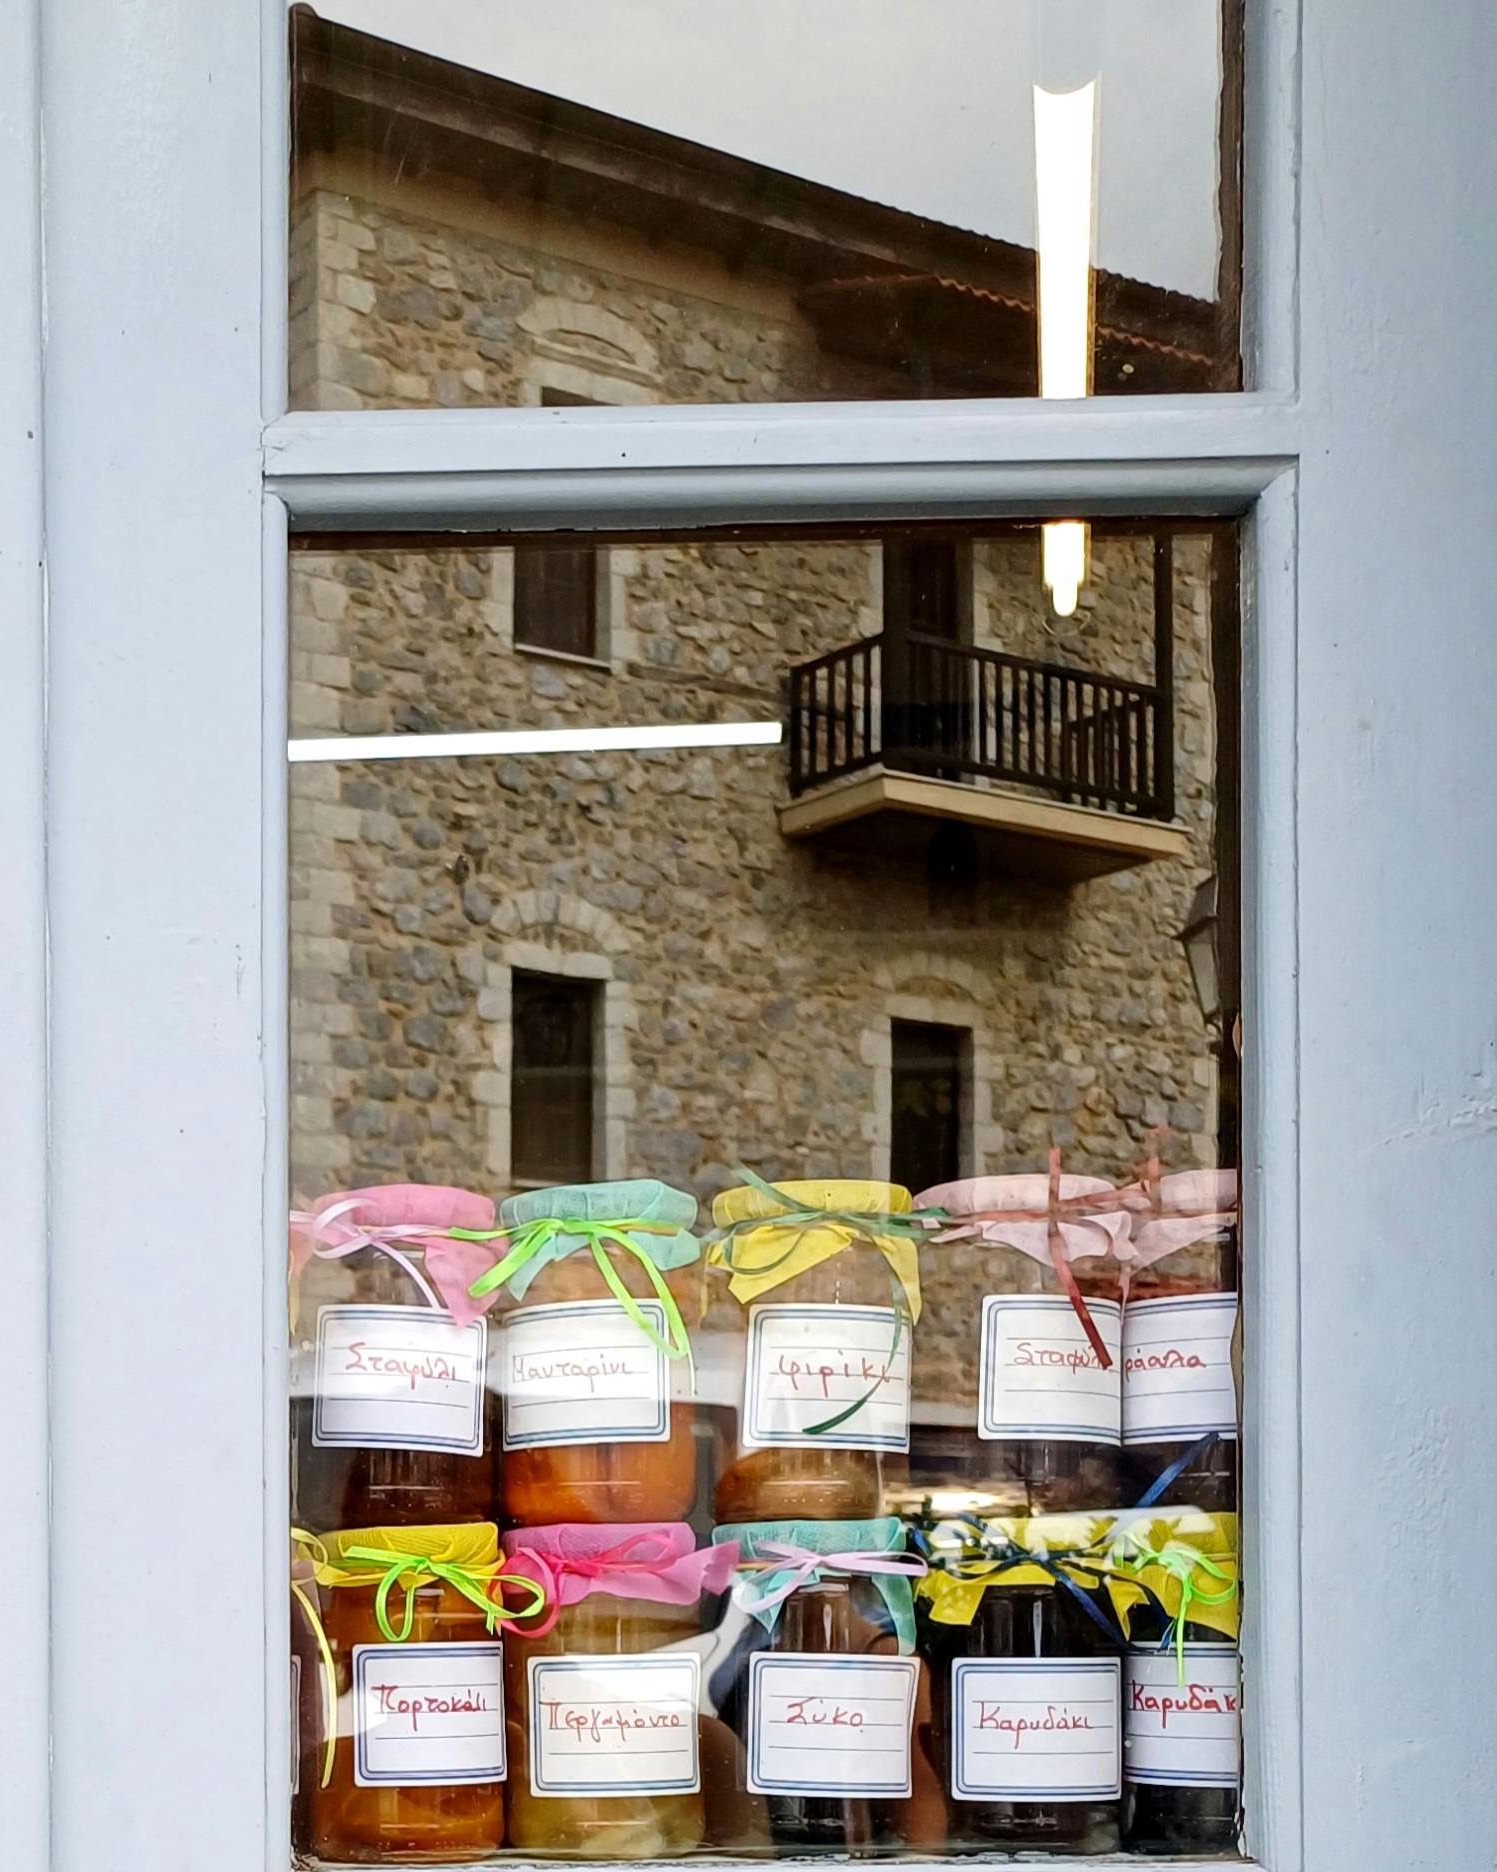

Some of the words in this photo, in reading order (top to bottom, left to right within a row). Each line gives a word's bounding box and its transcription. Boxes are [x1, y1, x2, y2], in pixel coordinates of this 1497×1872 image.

[344, 1342, 457, 1390] Σταφύλι
[1123, 1348, 1207, 1382] ράουλα
[977, 1701, 1095, 1749] Καρυδάκι
[1131, 1679, 1237, 1729] Καρυδάκ
